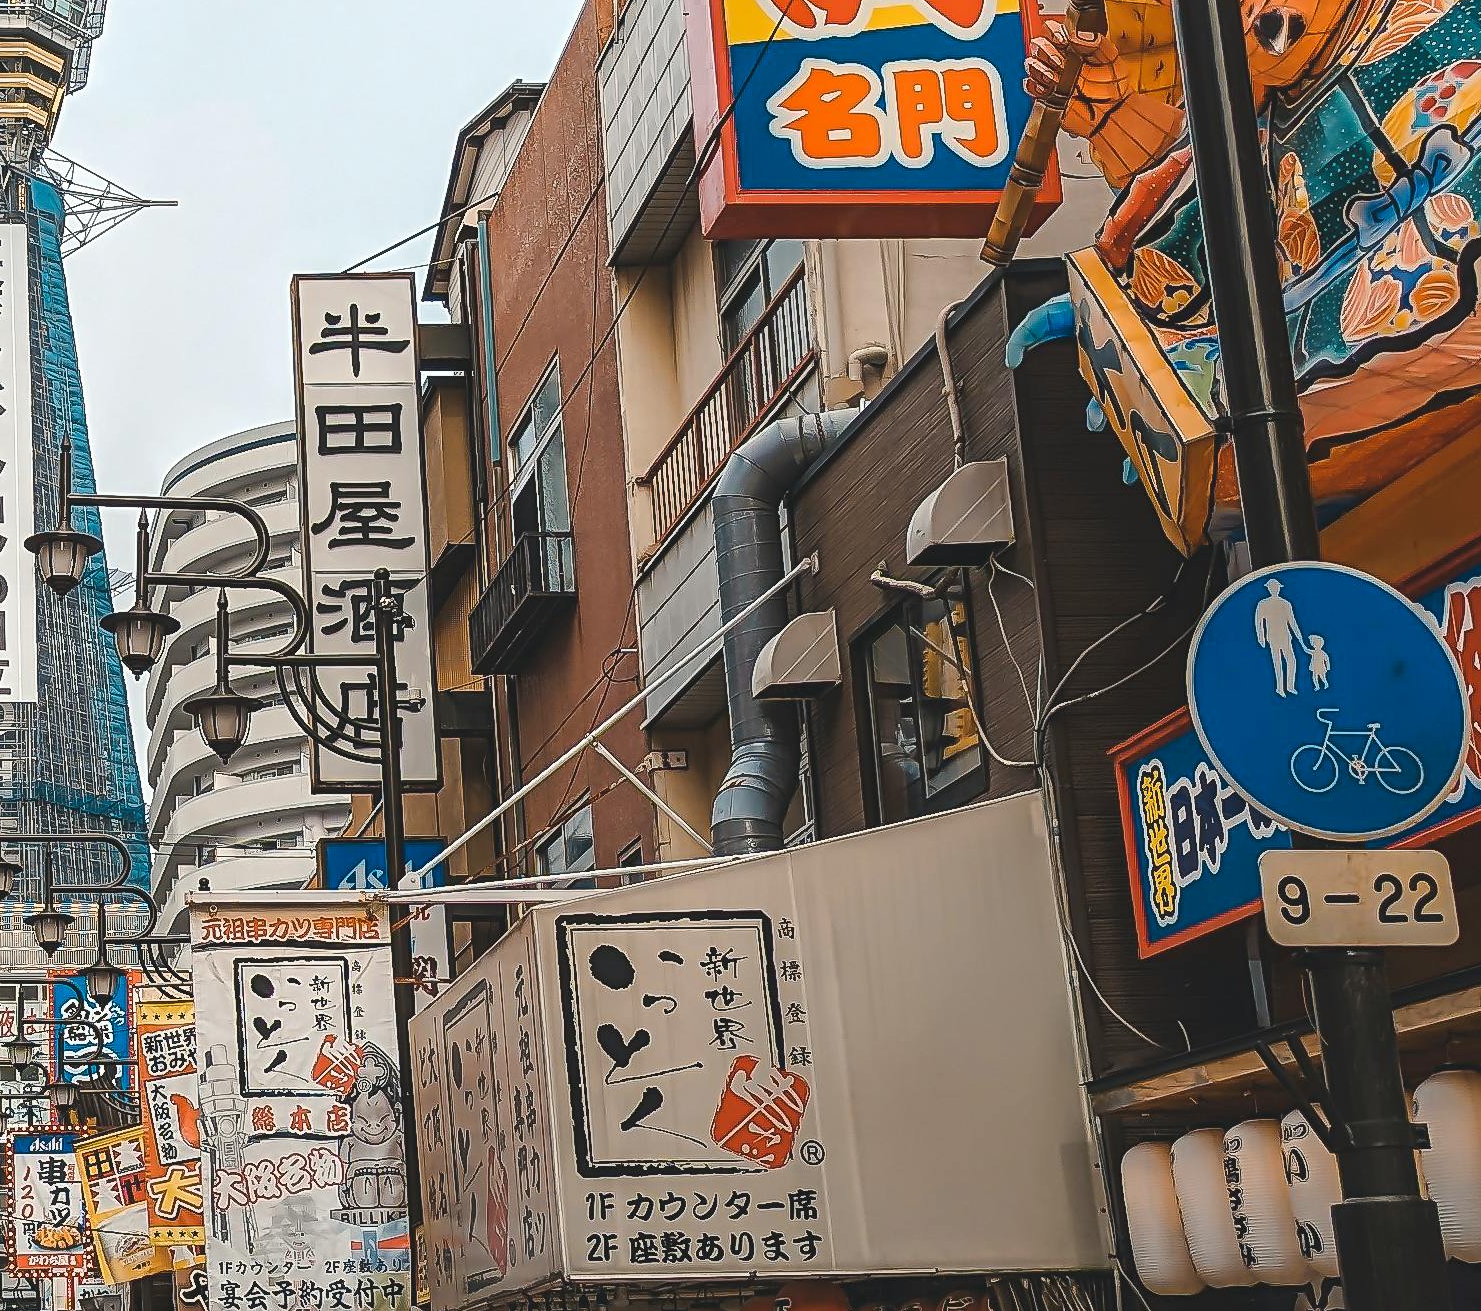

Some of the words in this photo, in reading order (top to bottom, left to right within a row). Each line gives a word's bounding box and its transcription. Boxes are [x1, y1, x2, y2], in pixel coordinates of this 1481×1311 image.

[779, 66, 1000, 160] 名門
[1142, 767, 1177, 923] 新世界
[202, 917, 380, 941] 元祖串カツ専門店
[308, 975, 337, 1031] 新世界
[699, 946, 754, 1051] 新世界
[777, 918, 813, 1068] 商標登録
[30, 1137, 63, 1152] Asahi
[252, 1106, 350, 1134] 総本店
[214, 1148, 348, 1211] 大阪名物
[218, 1278, 406, 1310] 宴会予約受付中
